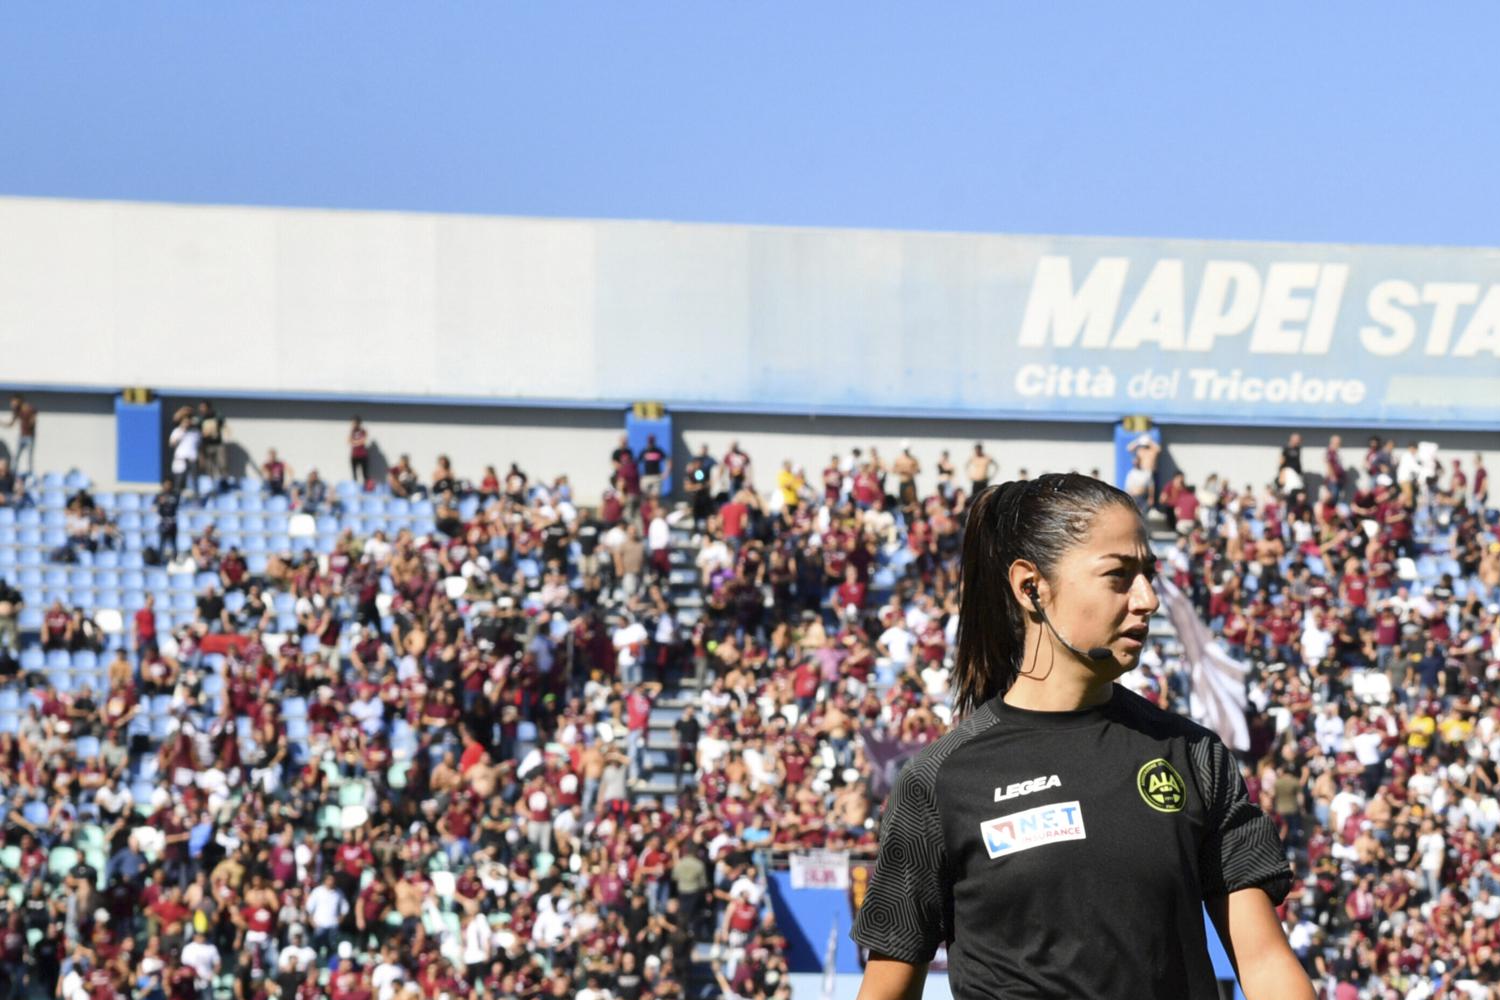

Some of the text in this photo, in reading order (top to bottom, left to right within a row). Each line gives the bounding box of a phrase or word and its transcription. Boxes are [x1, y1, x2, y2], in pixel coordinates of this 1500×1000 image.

[1018, 256, 1350, 354] MAPEI
[1015, 363, 1366, 405] Città del Tricolore
[994, 774, 1062, 803] LEGEA
[1148, 772, 1181, 793] AIA
[1019, 806, 1077, 834] NET
